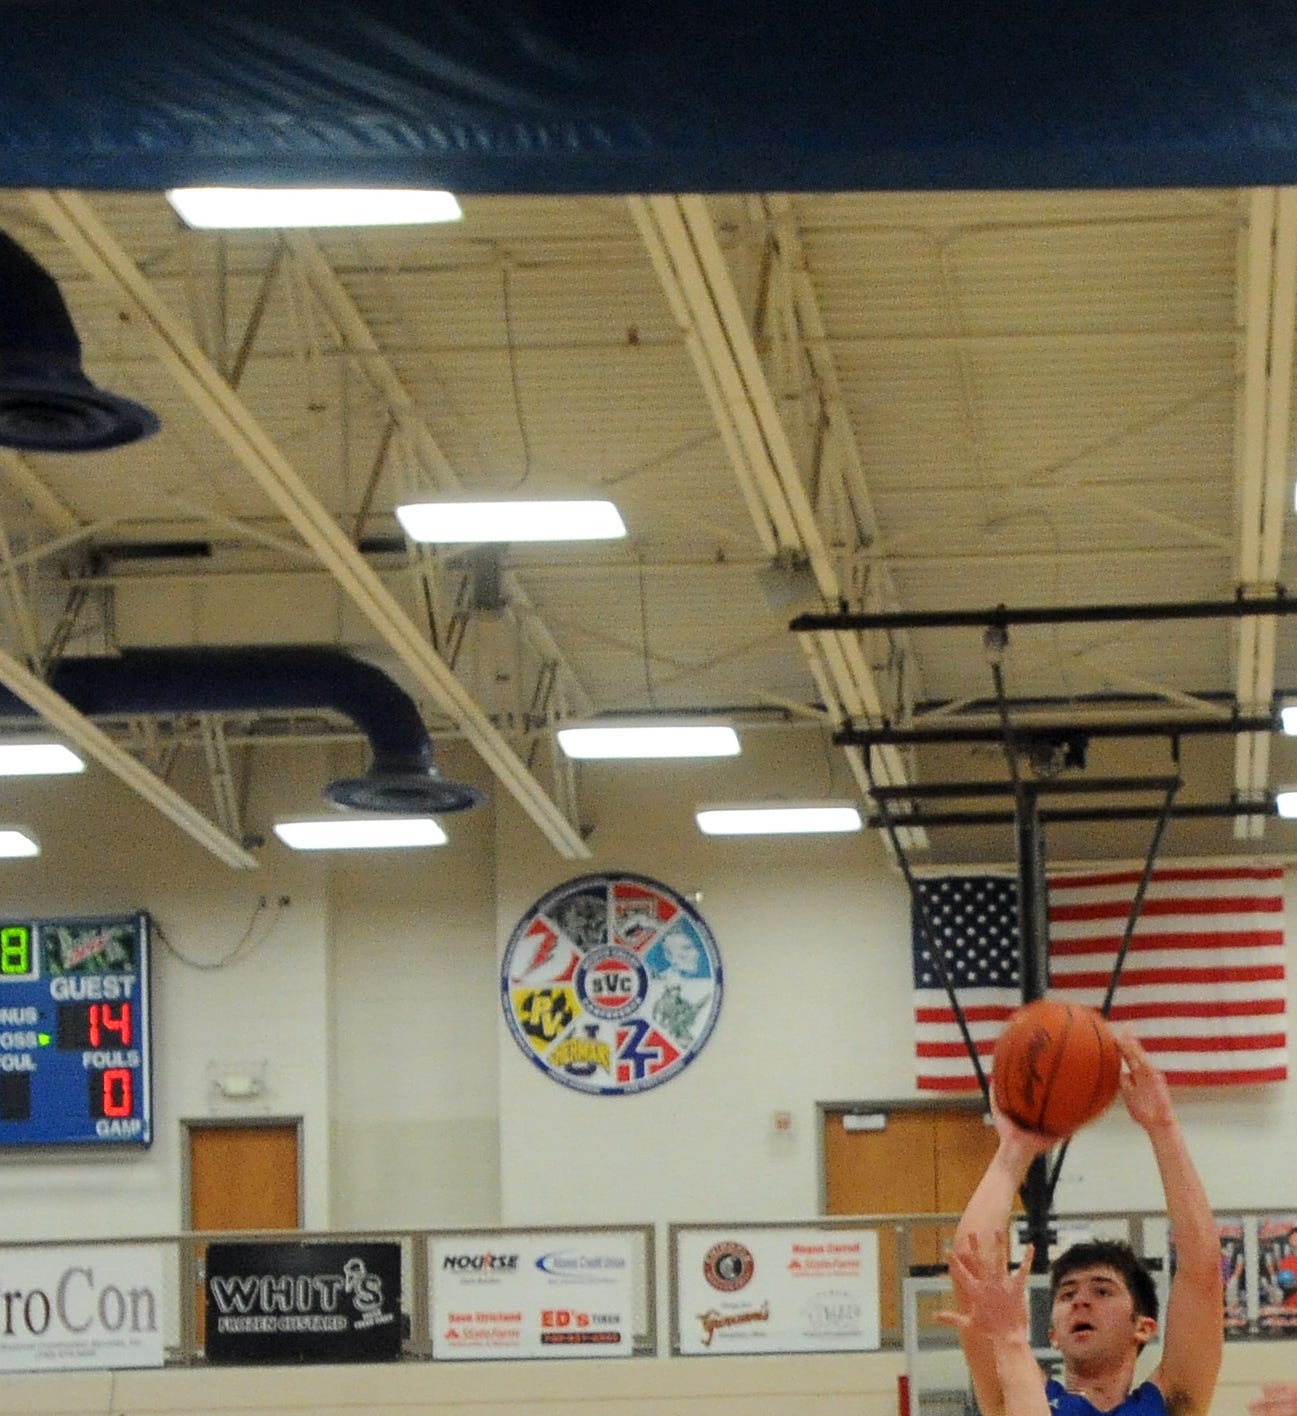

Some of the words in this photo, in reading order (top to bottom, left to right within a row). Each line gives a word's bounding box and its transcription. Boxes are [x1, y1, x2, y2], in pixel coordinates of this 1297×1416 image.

[1, 926, 29, 974] 8
[50, 974, 136, 1001] GUEST
[592, 974, 632, 994] SVC
[89, 1002, 131, 1047] 14
[82, 1050, 140, 1069] FOULS
[103, 1067, 133, 1119] 0
